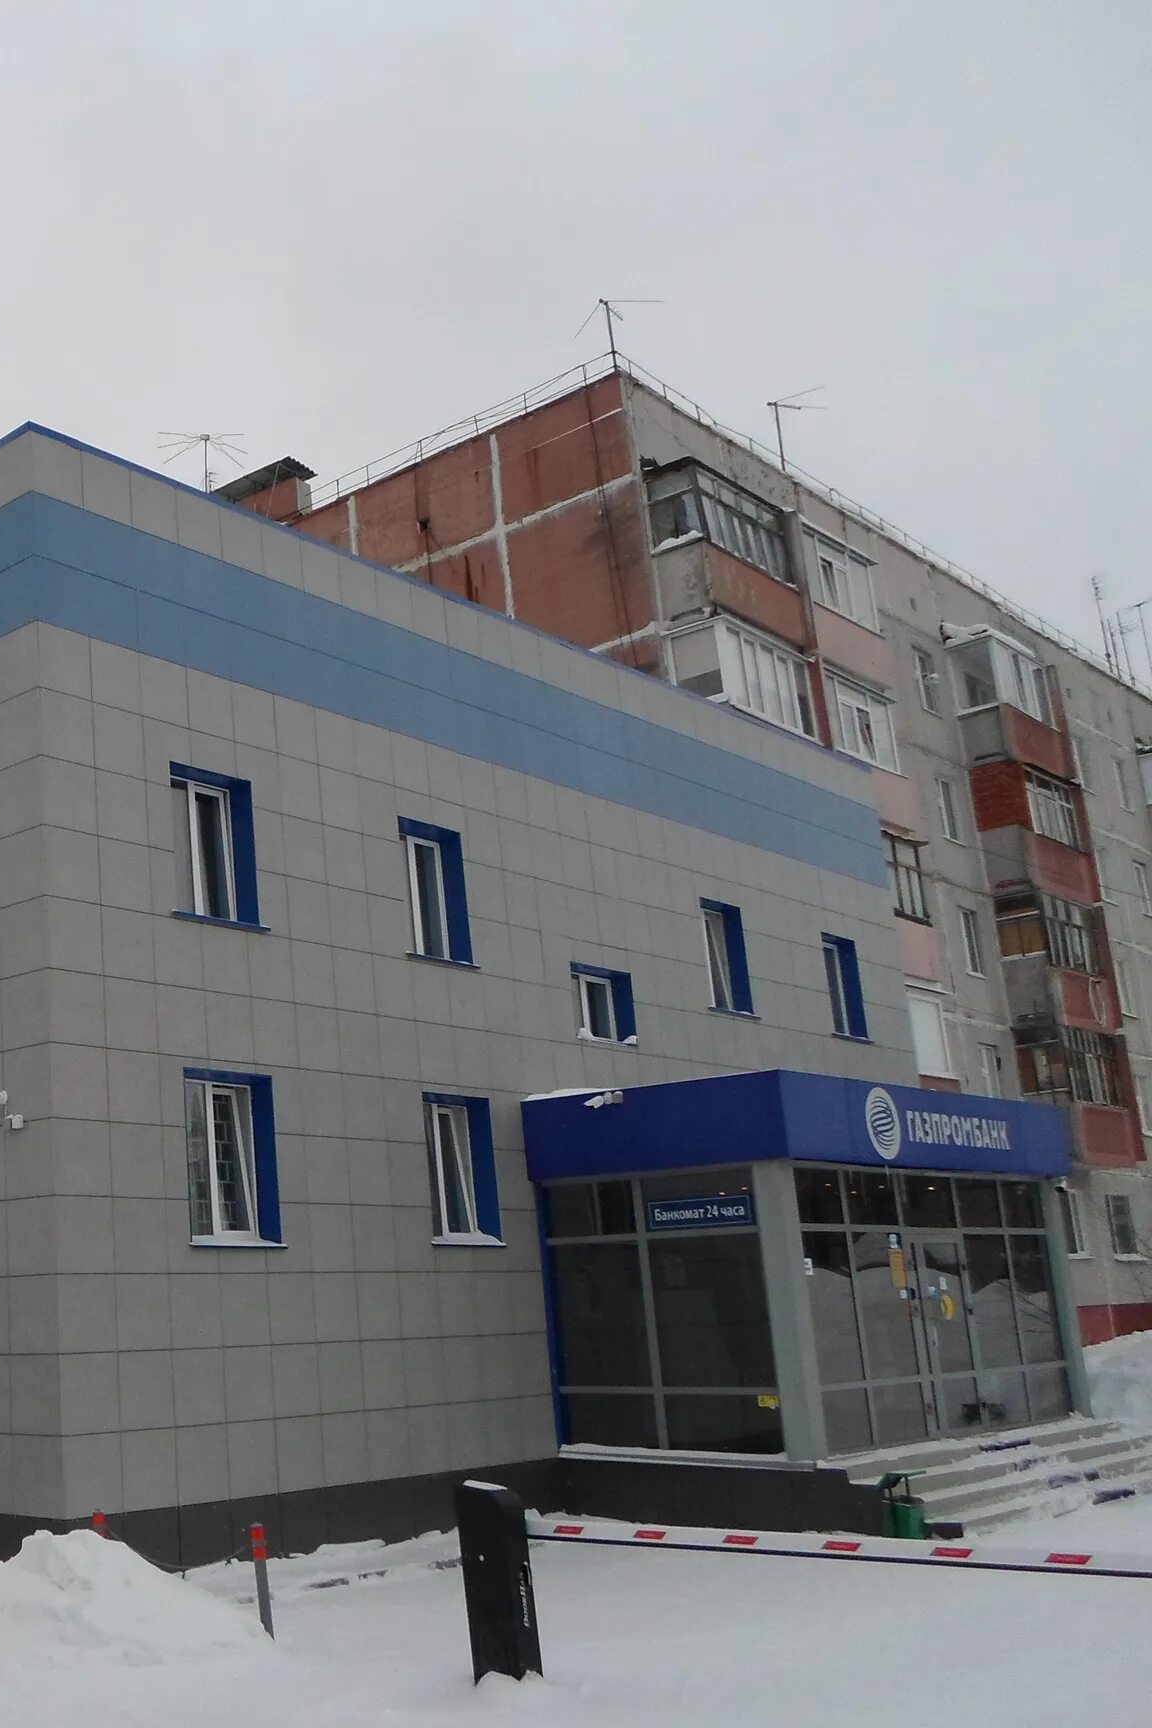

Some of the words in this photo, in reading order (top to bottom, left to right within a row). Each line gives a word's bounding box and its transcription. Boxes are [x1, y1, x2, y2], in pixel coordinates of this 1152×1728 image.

[906, 1110, 1011, 1150] ГАЗПРОМБАНК
[654, 1208, 704, 1221] Банкомат
[706, 1205, 719, 1218] 24
[720, 1205, 745, 1217] часа
